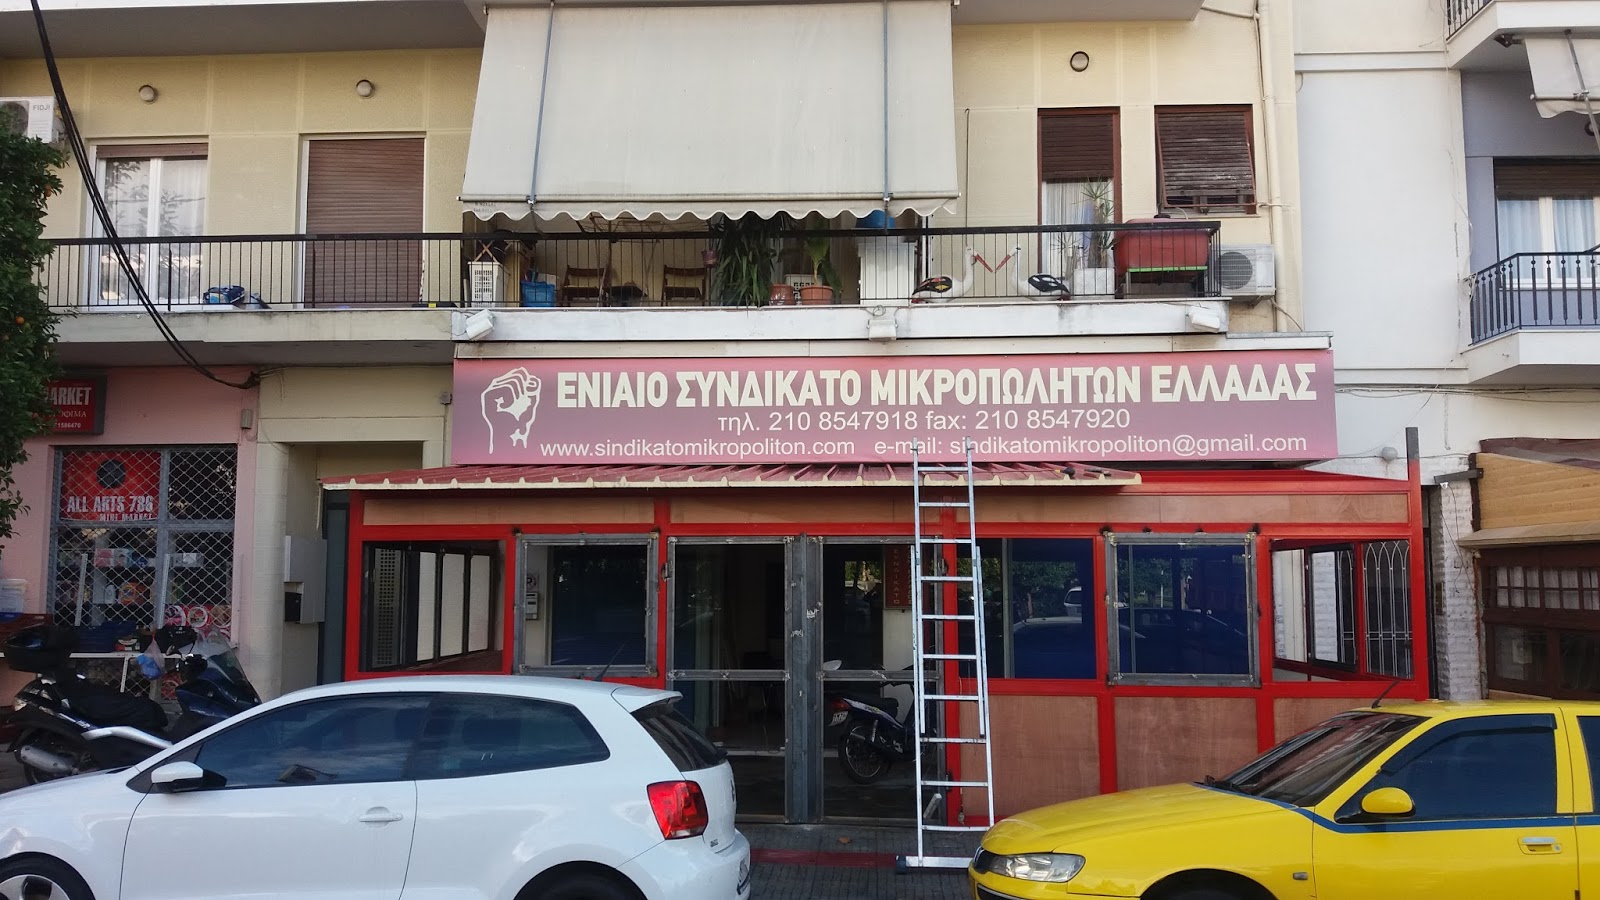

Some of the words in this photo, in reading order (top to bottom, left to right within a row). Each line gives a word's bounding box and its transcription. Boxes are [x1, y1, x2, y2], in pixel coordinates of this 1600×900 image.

[49, 386, 92, 405] ARKET
[557, 371, 669, 408] ΕΝΙΑΙΟ
[676, 369, 862, 408] ΣΥΝΔΙΚΑΤΟ
[870, 366, 1141, 406] ΜΙΚΡΟΠΩΛΗΤΩΝ
[1151, 363, 1317, 403] ΕΛΛΑΔΑΣ
[717, 412, 760, 436] τηλ.
[768, 411, 811, 431] 210
[818, 410, 918, 431] 8547918
[925, 410, 967, 430] fax:
[975, 409, 1019, 430] 210
[1026, 408, 1131, 429] 8547920
[540, 438, 855, 460] www.sindikatomikropoliton.com
[874, 437, 942, 455] e-mail:
[949, 434, 1307, 459] sindikatomikropoliton@gmail.com
[67, 496, 89, 513] ALL
